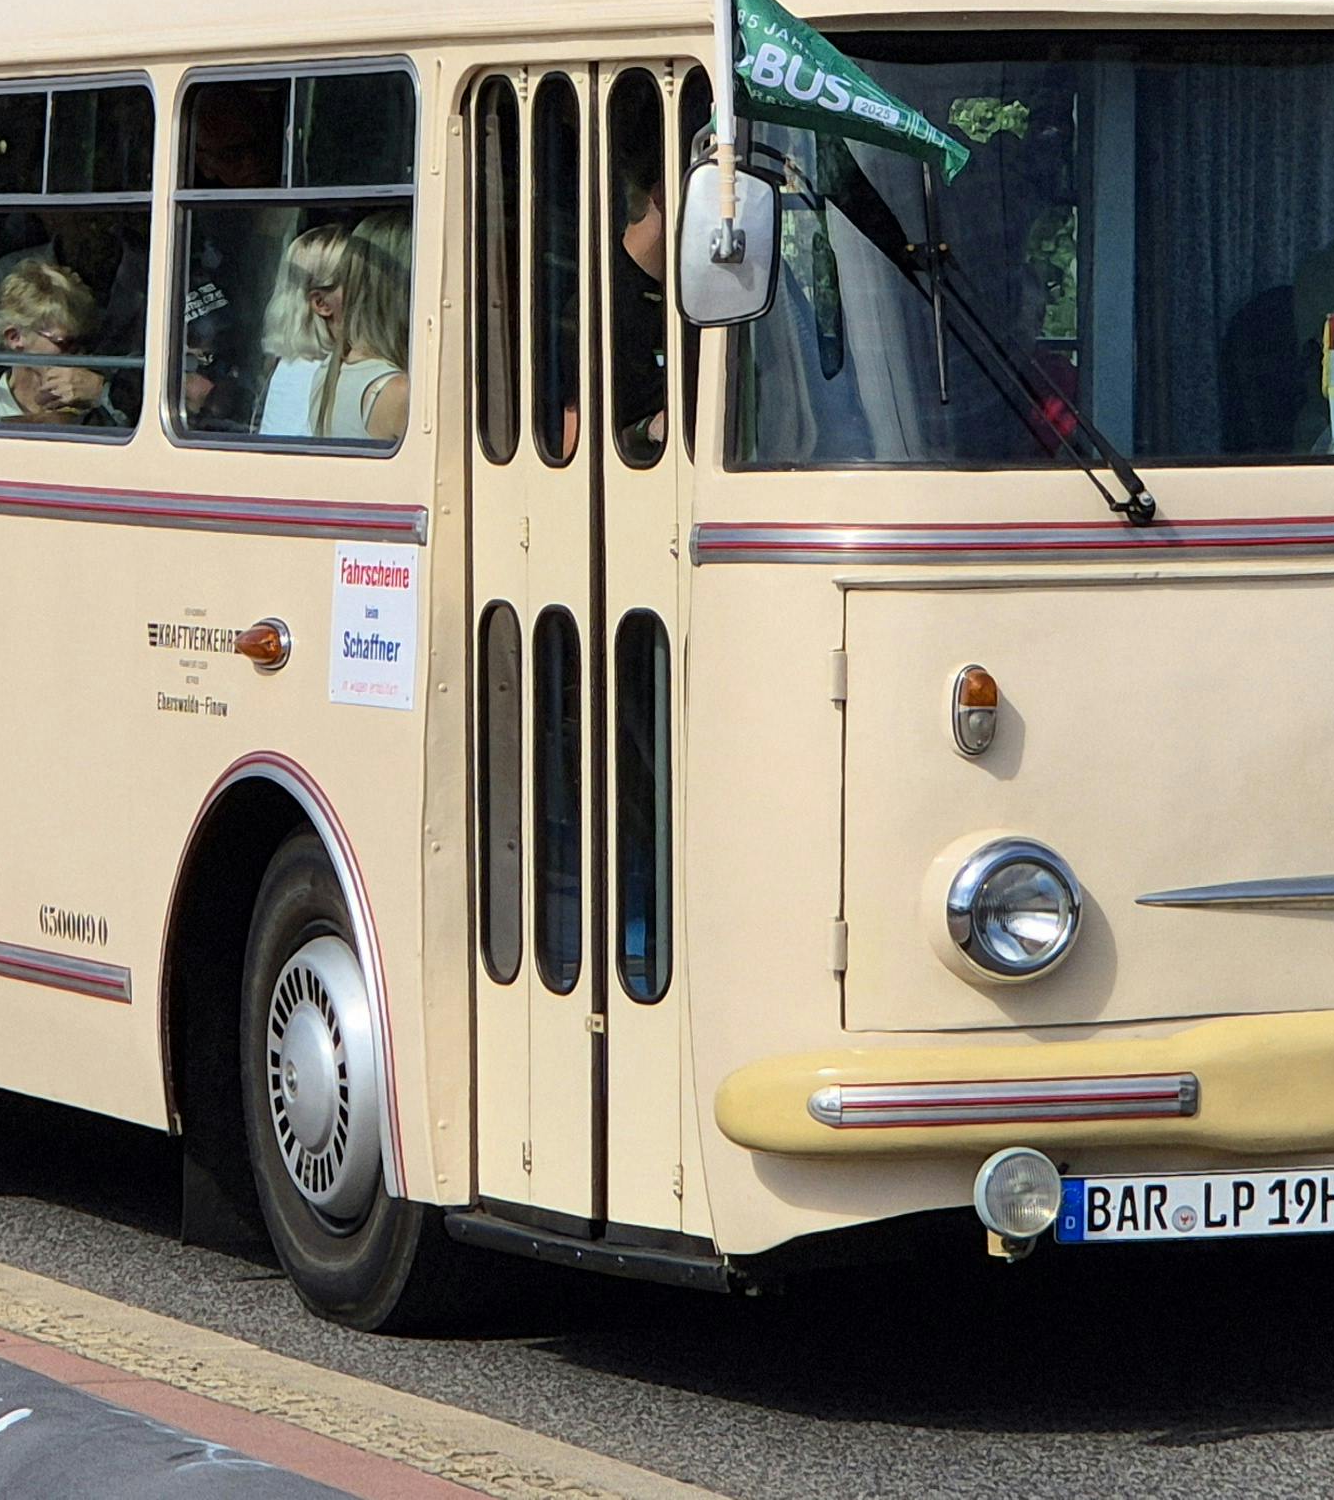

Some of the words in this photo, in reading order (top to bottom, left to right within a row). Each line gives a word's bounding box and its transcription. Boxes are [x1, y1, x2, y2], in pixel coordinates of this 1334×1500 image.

[860, 102, 891, 121] 2025
[340, 557, 409, 588] Fahrscheine
[158, 623, 233, 653] KRAFTVERKEHR
[343, 630, 401, 662] Schaffner
[1087, 1184, 1167, 1232] BAR
[1204, 1180, 1255, 1228] LP
